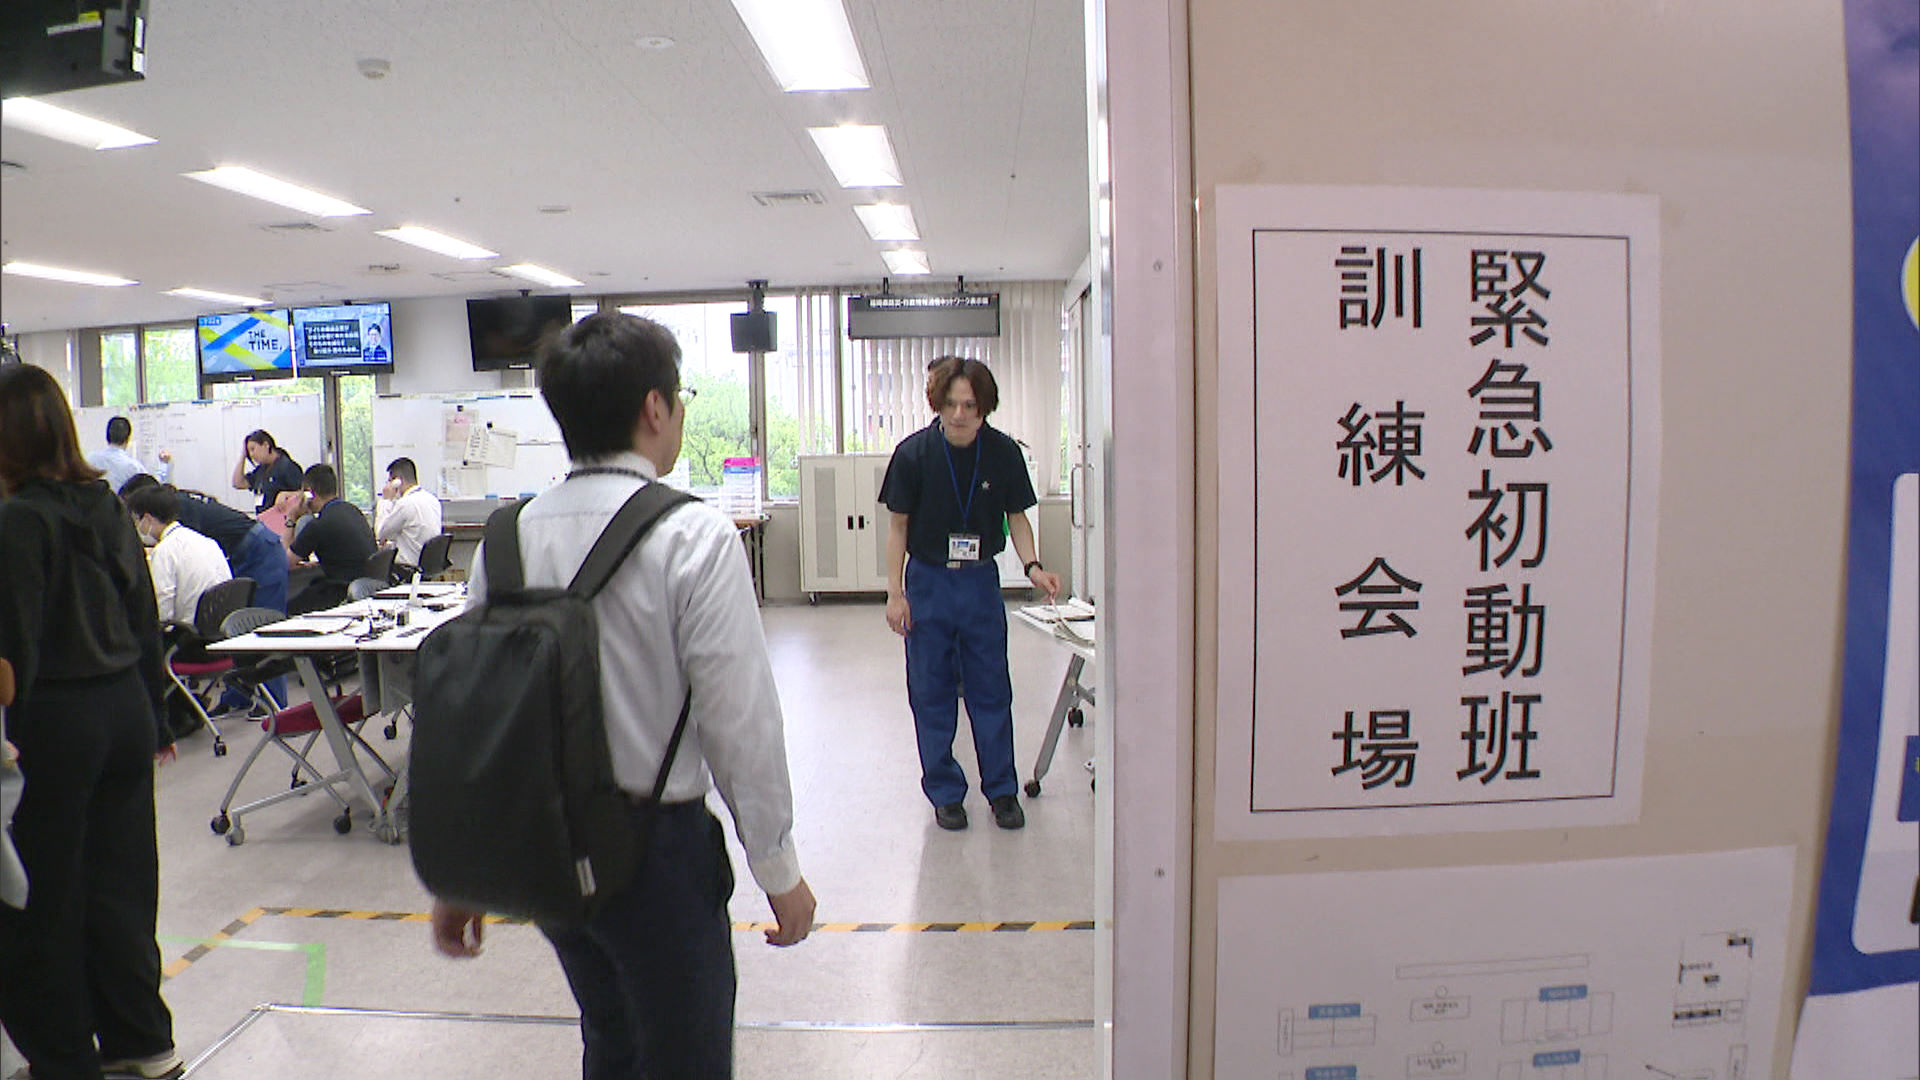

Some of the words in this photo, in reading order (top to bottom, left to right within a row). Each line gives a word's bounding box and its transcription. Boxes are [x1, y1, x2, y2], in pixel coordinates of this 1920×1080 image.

[247, 329, 266, 339] THE
[1331, 246, 1426, 790] 訓練会場
[1456, 248, 1553, 786] 緊急初動班
